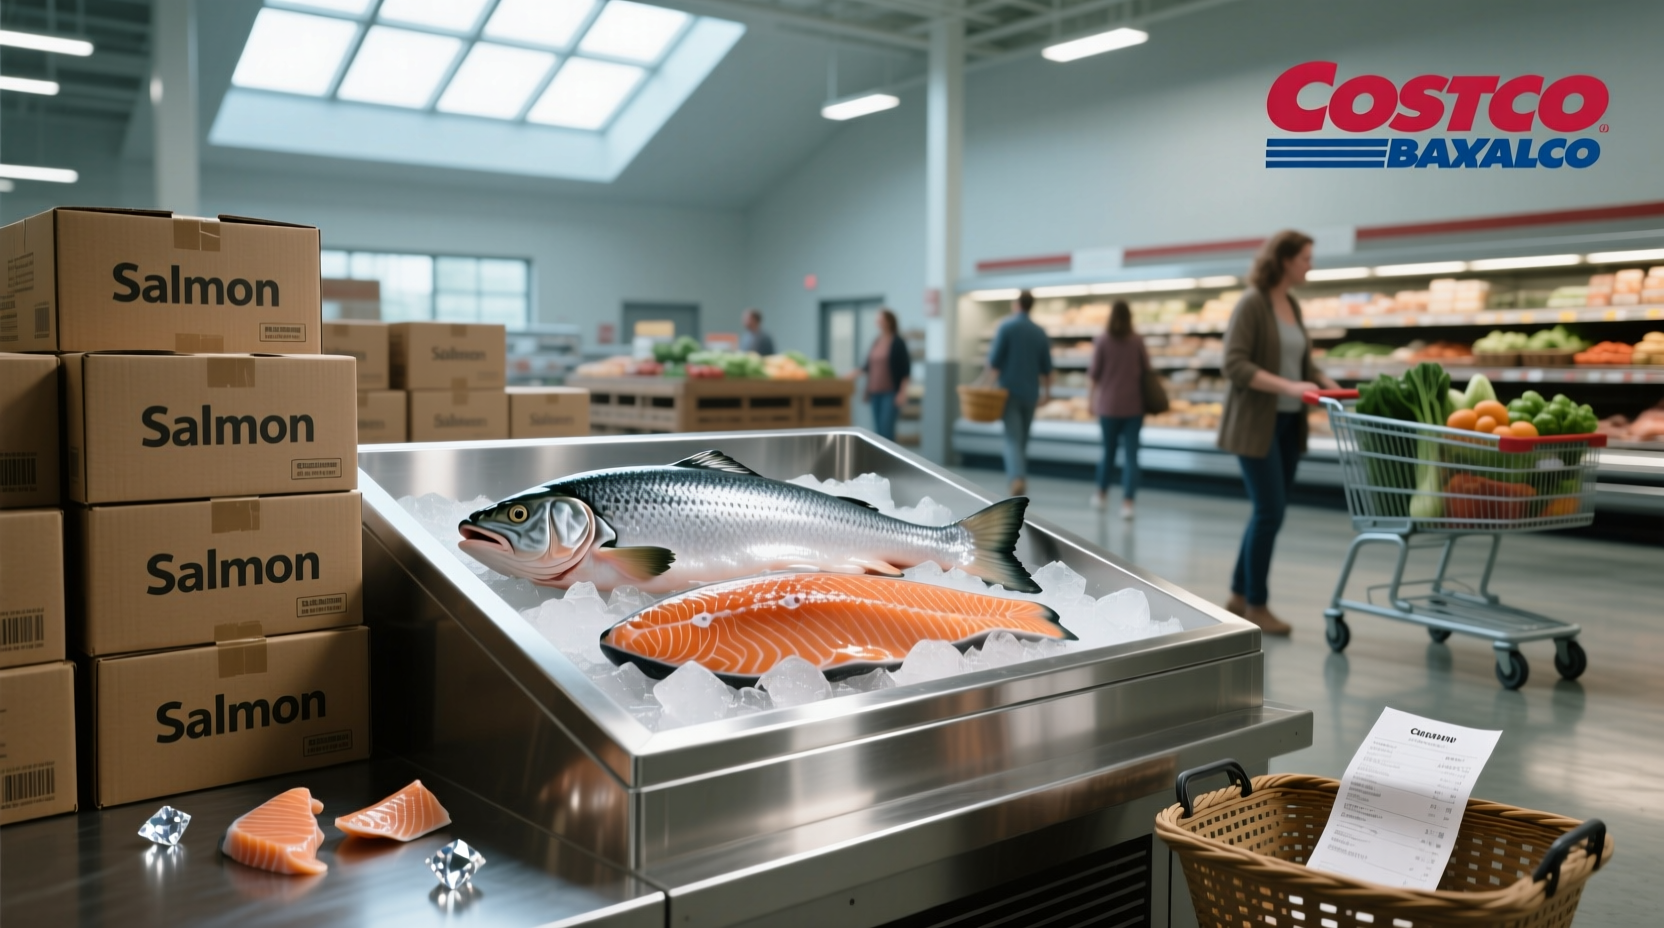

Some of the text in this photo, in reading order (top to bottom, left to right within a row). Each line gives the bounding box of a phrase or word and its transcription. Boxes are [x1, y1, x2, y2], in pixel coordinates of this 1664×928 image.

[1266, 61, 1610, 133] COSTCO
[1386, 138, 1601, 169] BAXALCO
[112, 262, 280, 307] Salmon
[141, 404, 315, 448] Salmon
[146, 549, 320, 596] Salmon
[156, 690, 327, 744] Salmon
